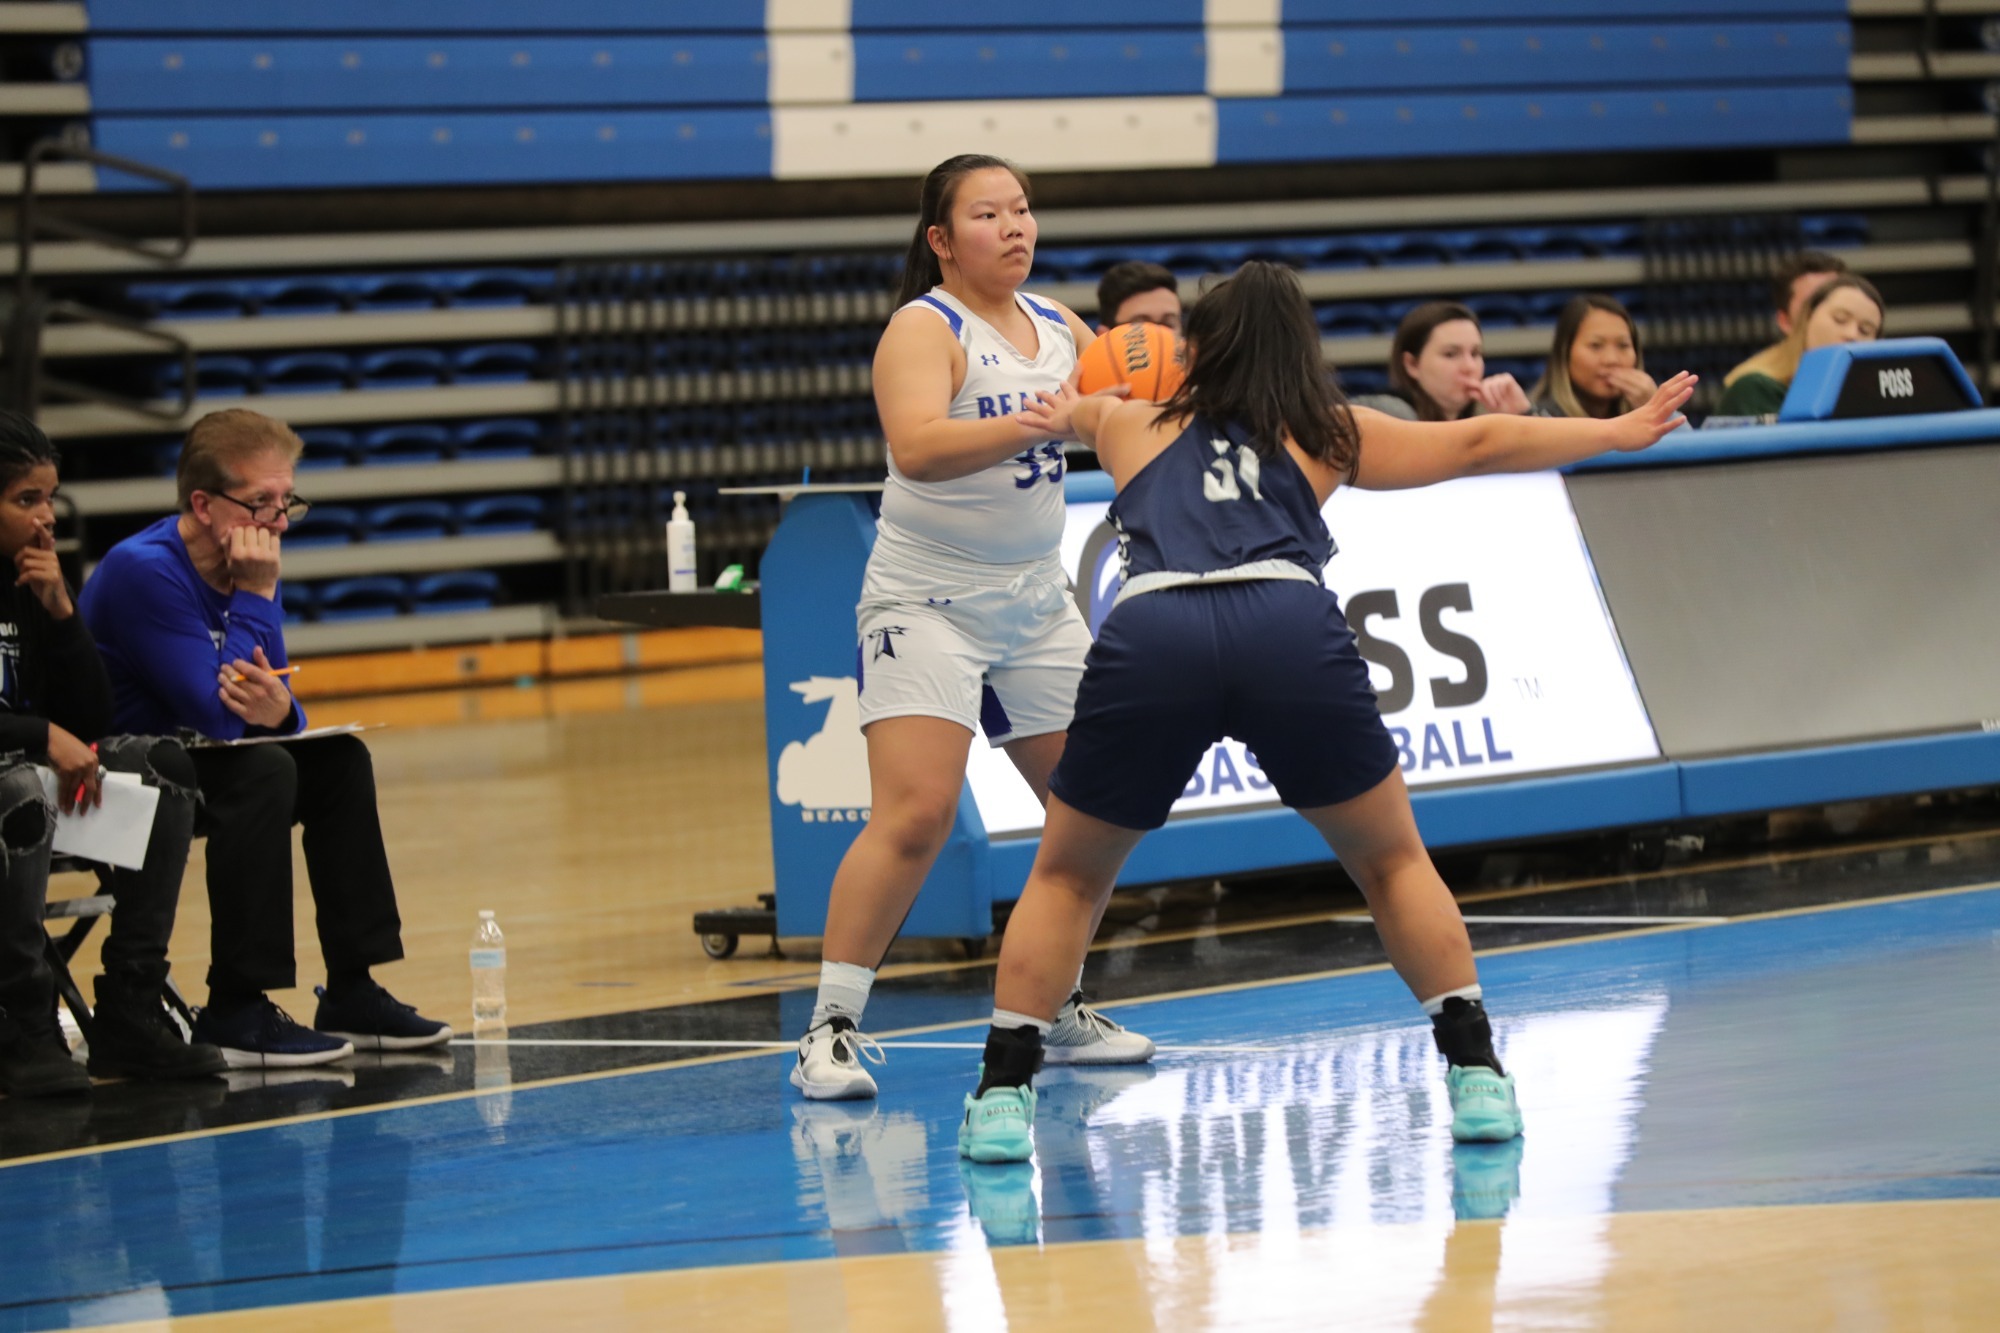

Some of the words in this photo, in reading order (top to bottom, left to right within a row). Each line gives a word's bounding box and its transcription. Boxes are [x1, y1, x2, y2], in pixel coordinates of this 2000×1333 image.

[1878, 367, 1914, 399] POSS
[1344, 582, 1488, 715] SS
[801, 808, 871, 823] BEACO
